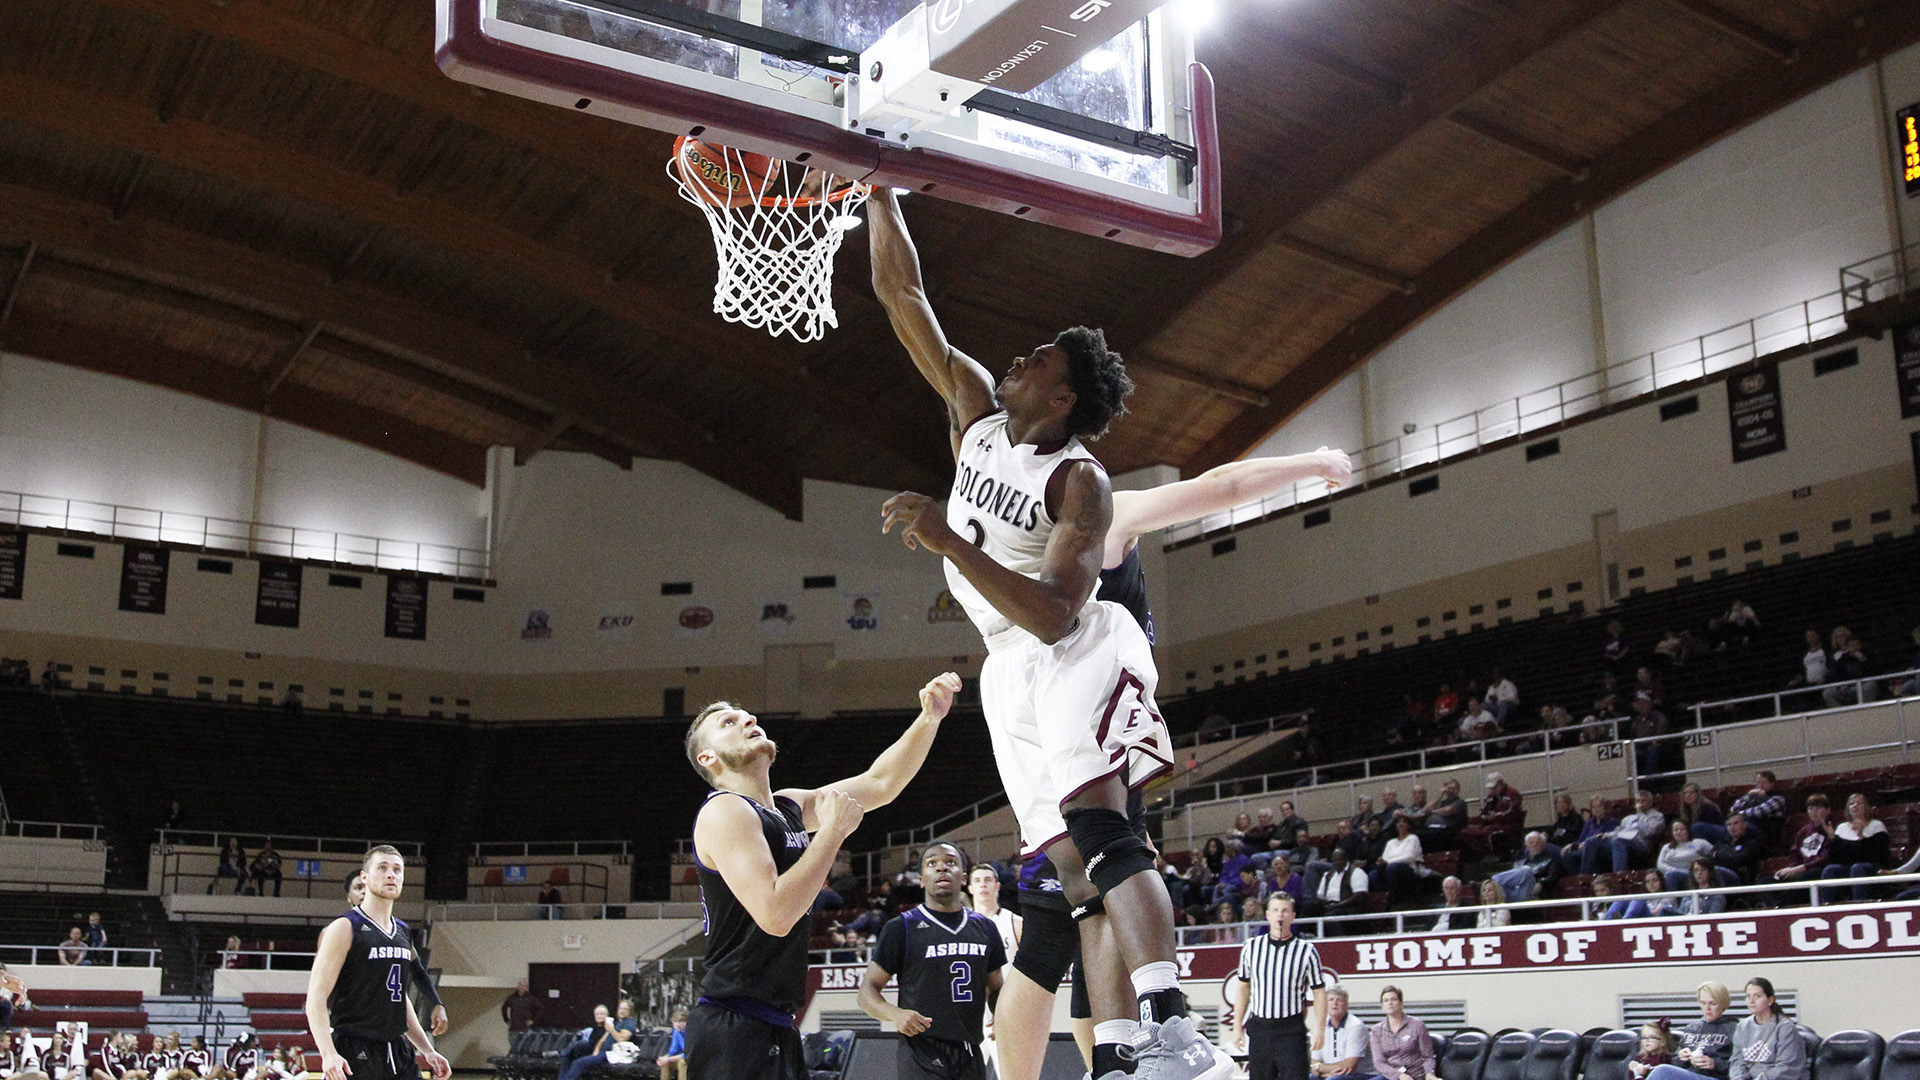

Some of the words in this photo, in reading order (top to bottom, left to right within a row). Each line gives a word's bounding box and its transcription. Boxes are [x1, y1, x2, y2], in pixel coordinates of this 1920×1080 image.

[979, 40, 1049, 84] LEXINGTON
[1126, 708, 1141, 728] E
[1599, 745, 1623, 759] 214
[925, 943, 987, 958] ASBURY
[1356, 936, 1502, 971] HOME
[1526, 930, 1598, 964] OF
[1622, 921, 1759, 959] THE
[1789, 911, 1920, 952] COL
[386, 964, 402, 1002] 4
[950, 961, 973, 1002] 2
[1683, 1032, 1729, 1045] EKU
